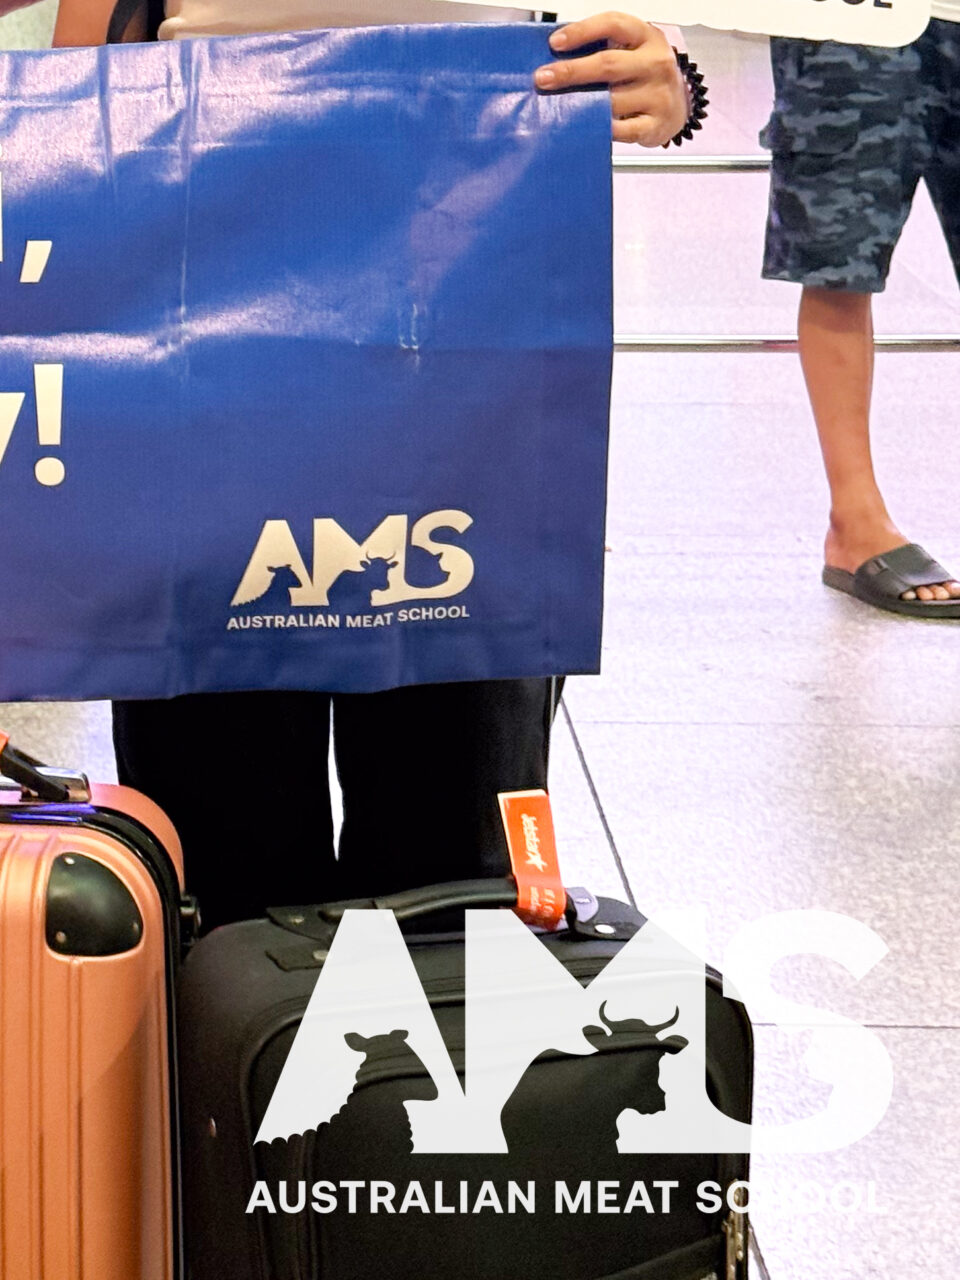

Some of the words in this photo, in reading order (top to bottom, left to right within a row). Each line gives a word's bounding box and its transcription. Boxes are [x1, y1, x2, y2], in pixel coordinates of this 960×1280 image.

[230, 508, 475, 607] AMS
[226, 612, 341, 631] AUSTRALIAN
[346, 611, 394, 629] MEAT
[397, 604, 471, 623] SCHOOL
